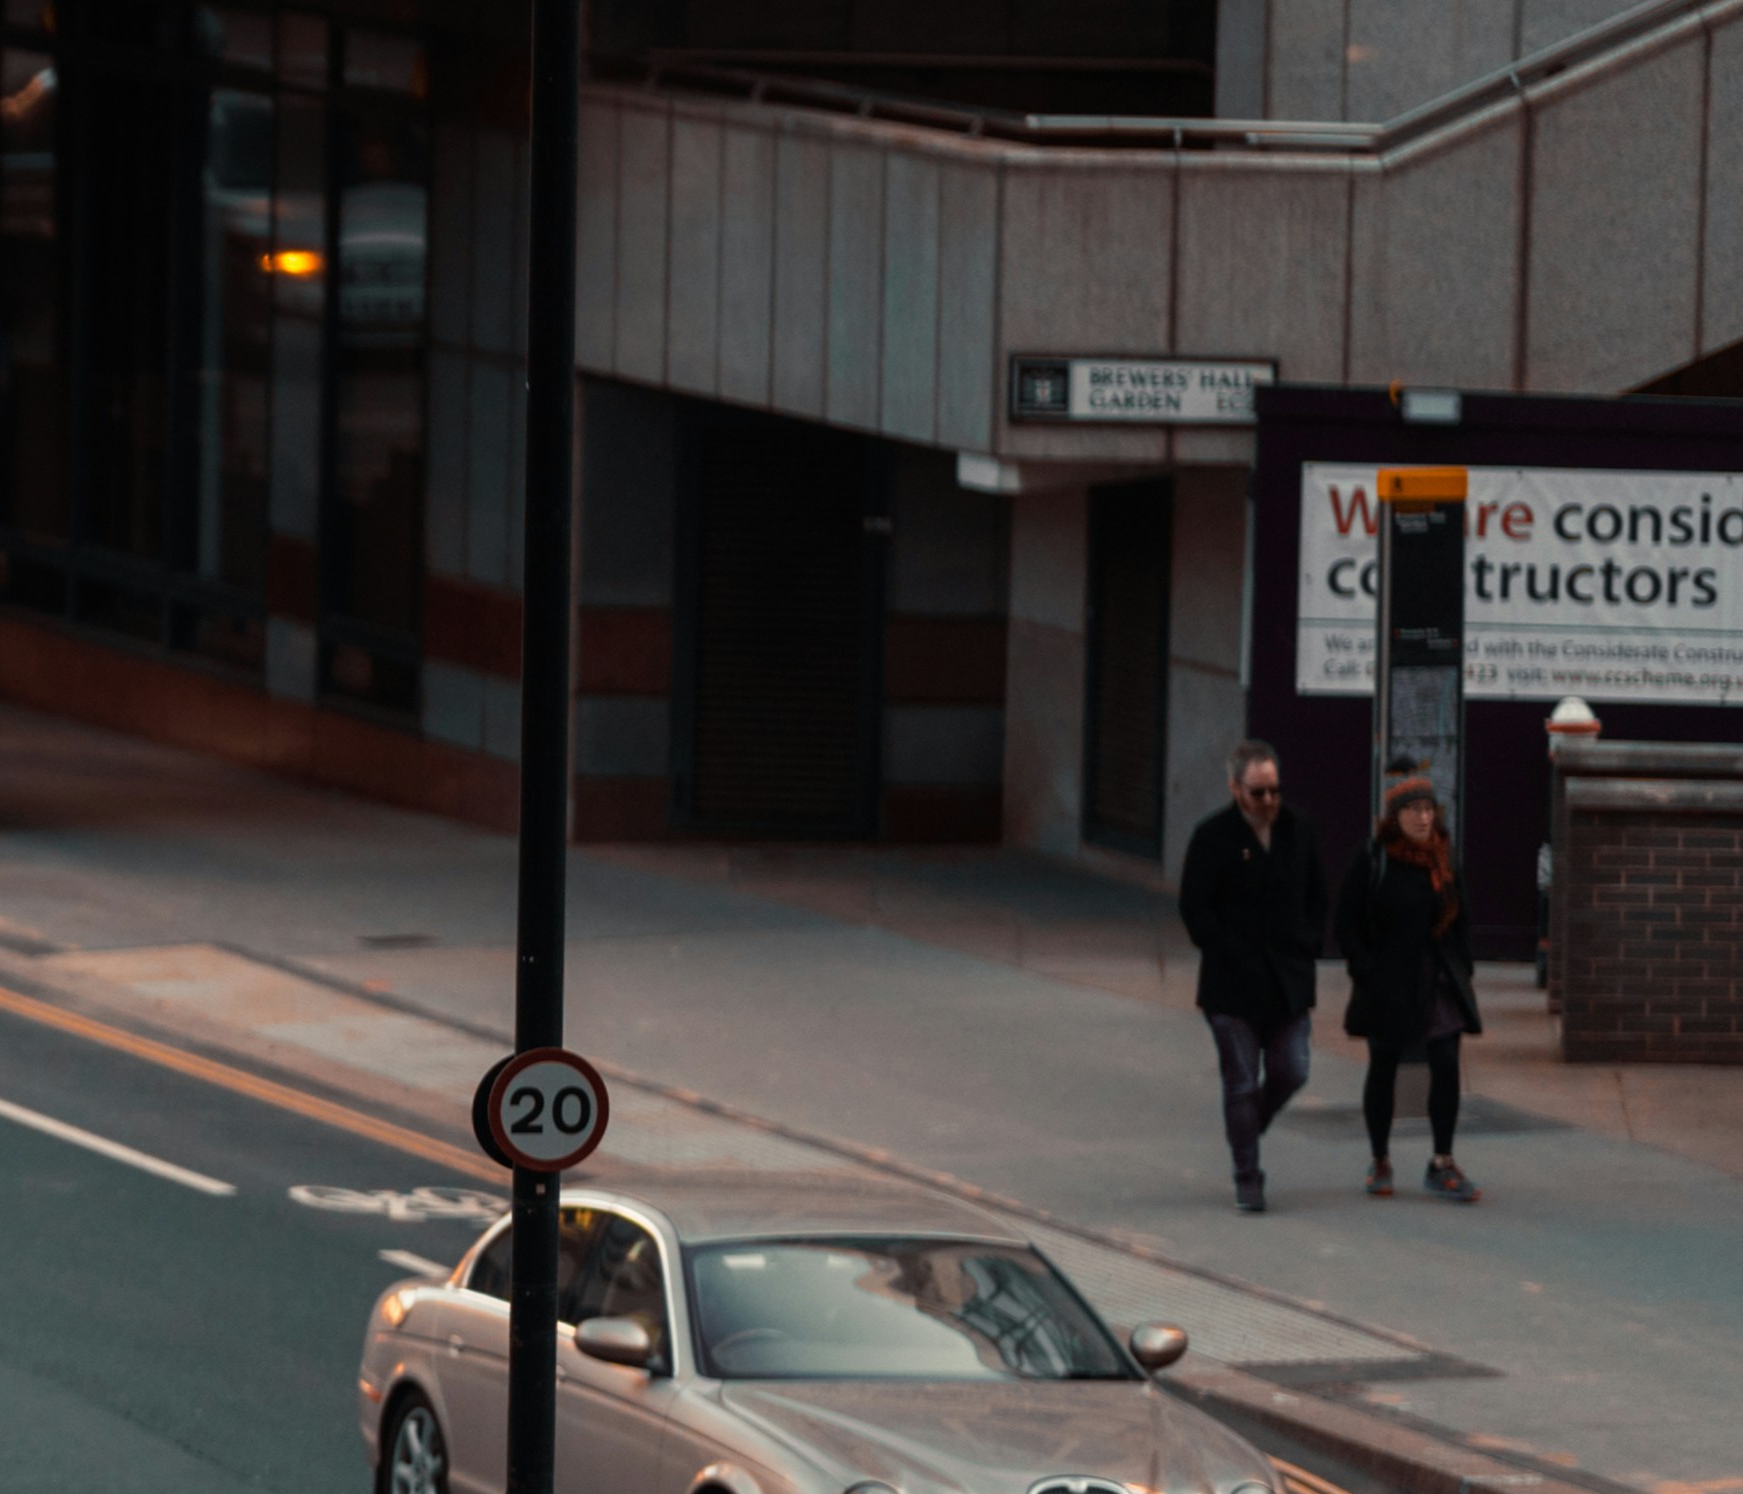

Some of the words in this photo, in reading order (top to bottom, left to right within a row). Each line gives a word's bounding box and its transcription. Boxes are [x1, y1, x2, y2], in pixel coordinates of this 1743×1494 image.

[1089, 367, 1192, 389] BREWERS'
[1199, 369, 1254, 389] HALL
[1089, 388, 1181, 411] GARDEN
[1329, 484, 1378, 537] W
[1464, 502, 1533, 541] re
[1526, 640, 1556, 658] the
[1561, 640, 1668, 662] Considerate
[510, 1086, 591, 1135] 20
